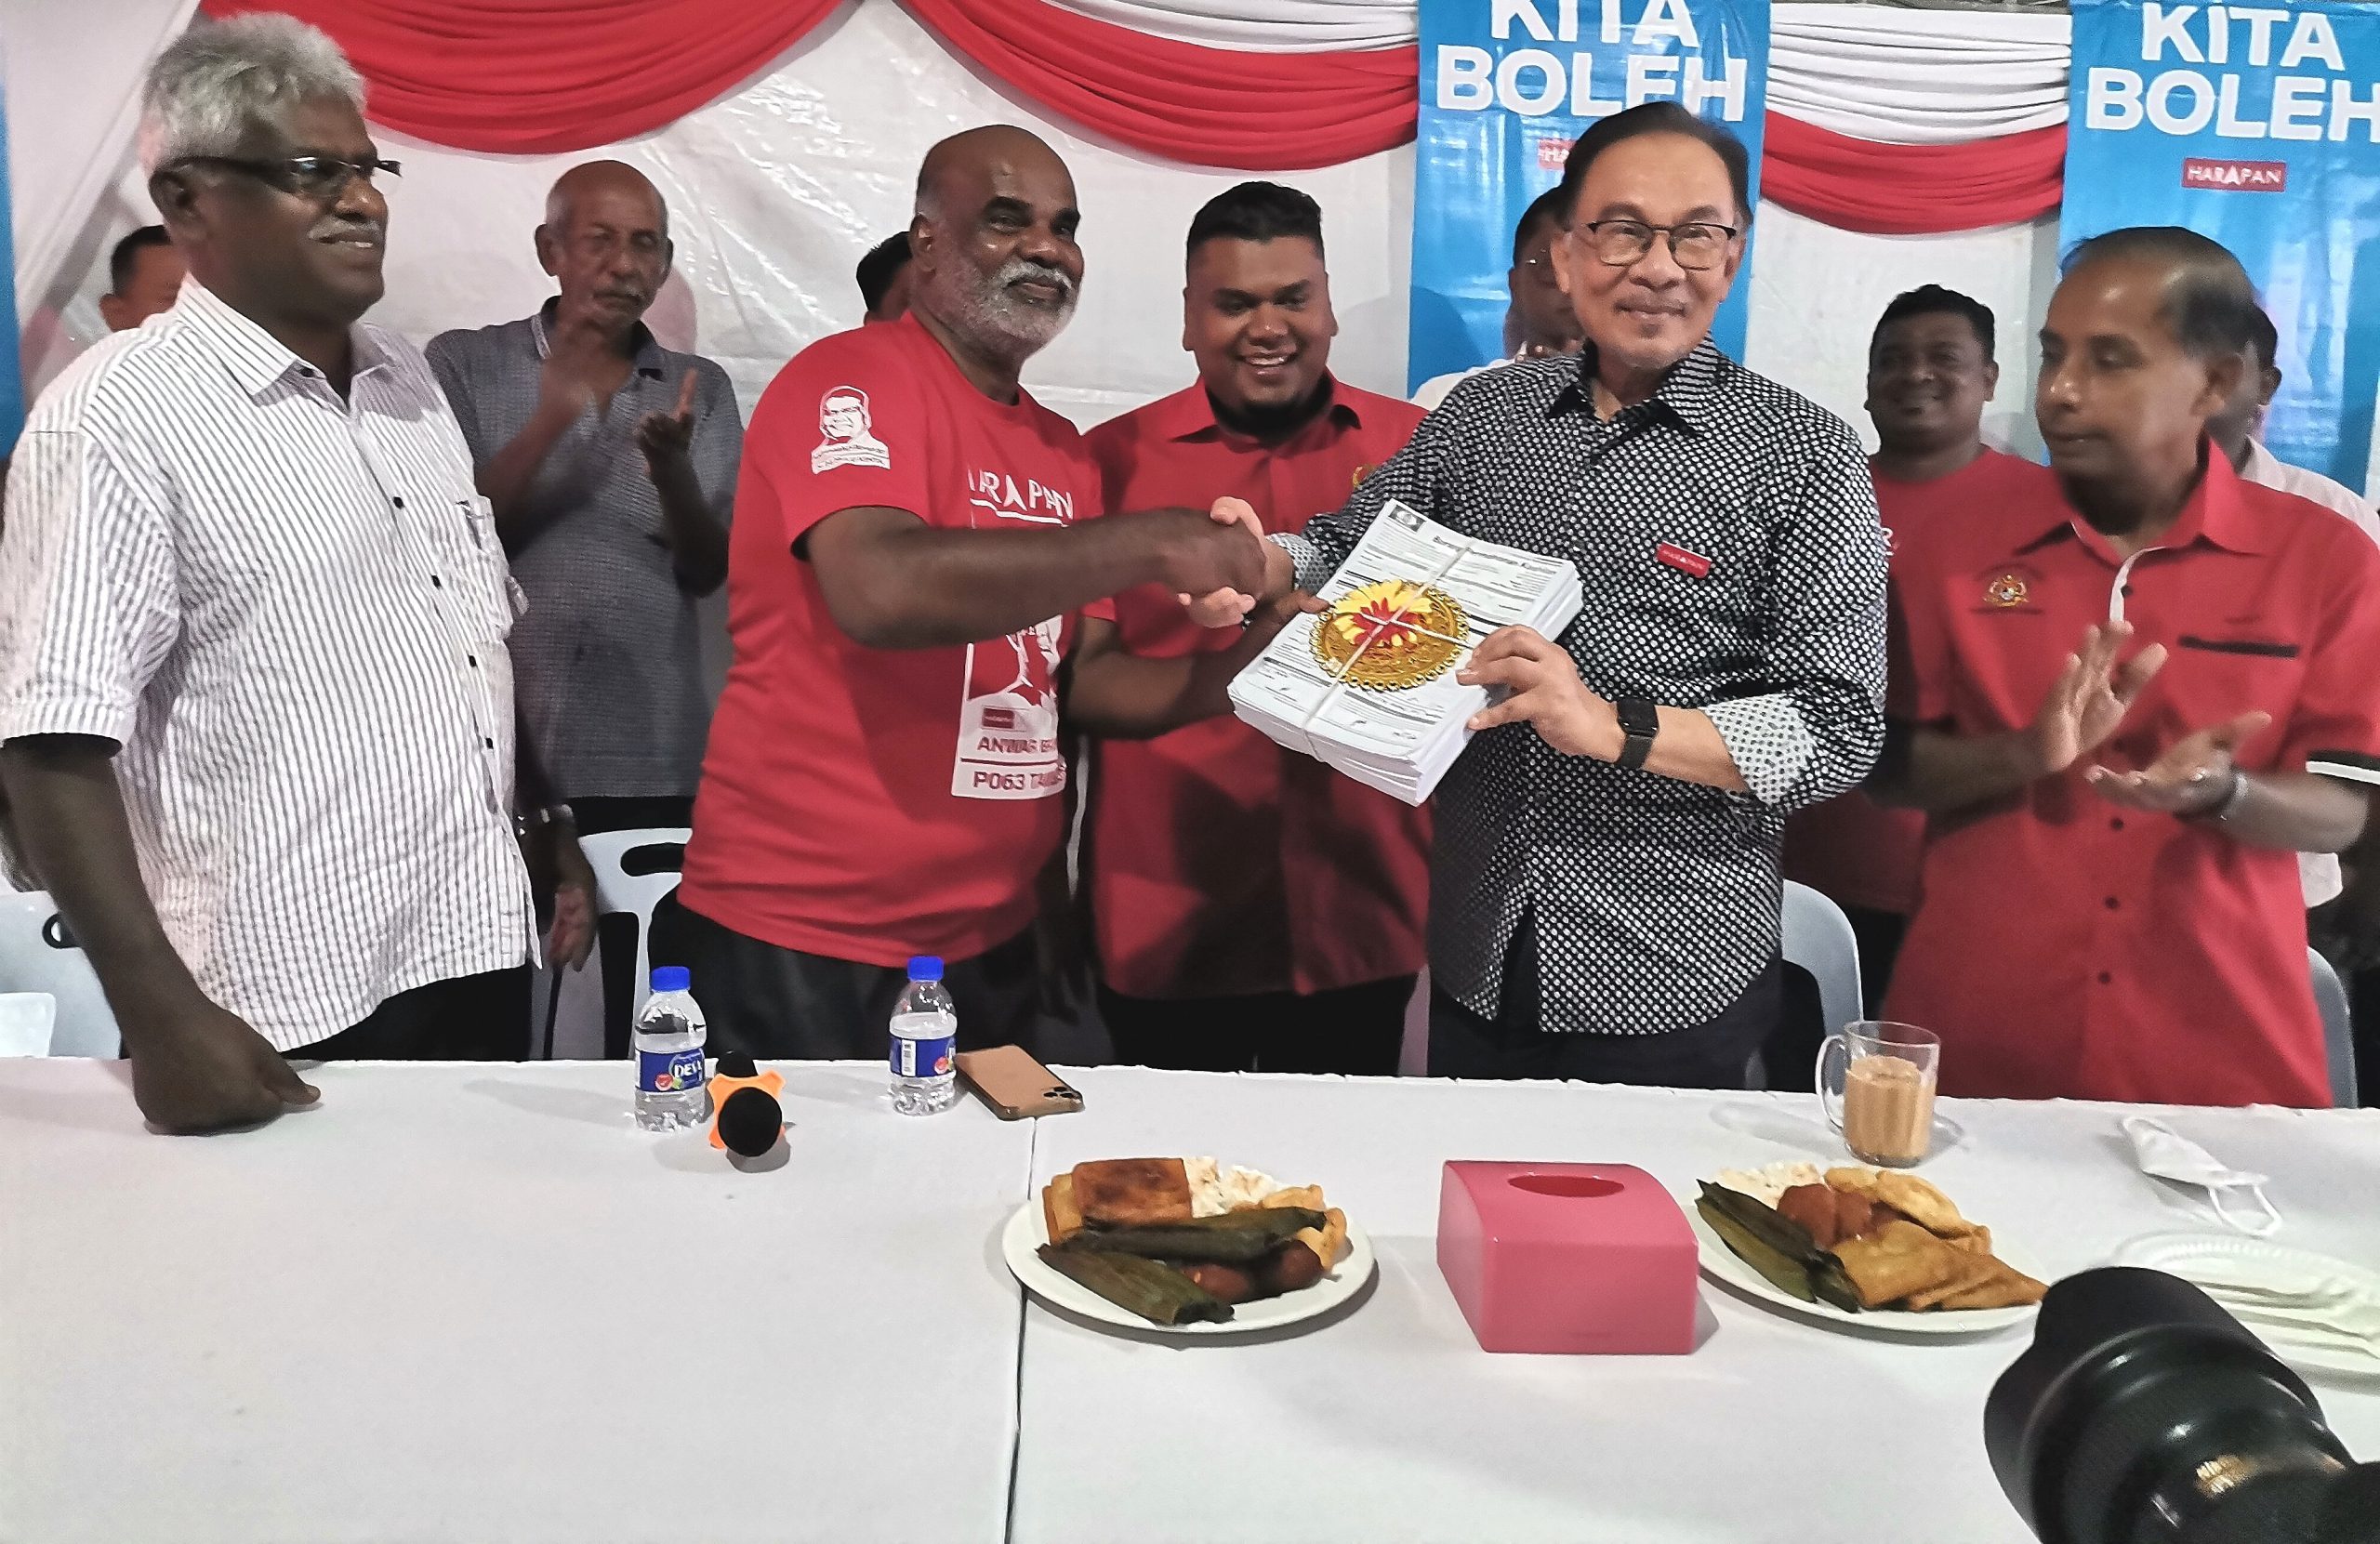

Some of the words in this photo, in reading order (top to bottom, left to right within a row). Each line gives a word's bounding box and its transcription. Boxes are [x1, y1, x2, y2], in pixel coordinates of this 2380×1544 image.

[2141, 3, 2347, 72] KITA
[1436, 44, 1749, 123] BOLEH
[2085, 66, 2380, 143] BOLEH
[2187, 165, 2283, 186] HARAPAN
